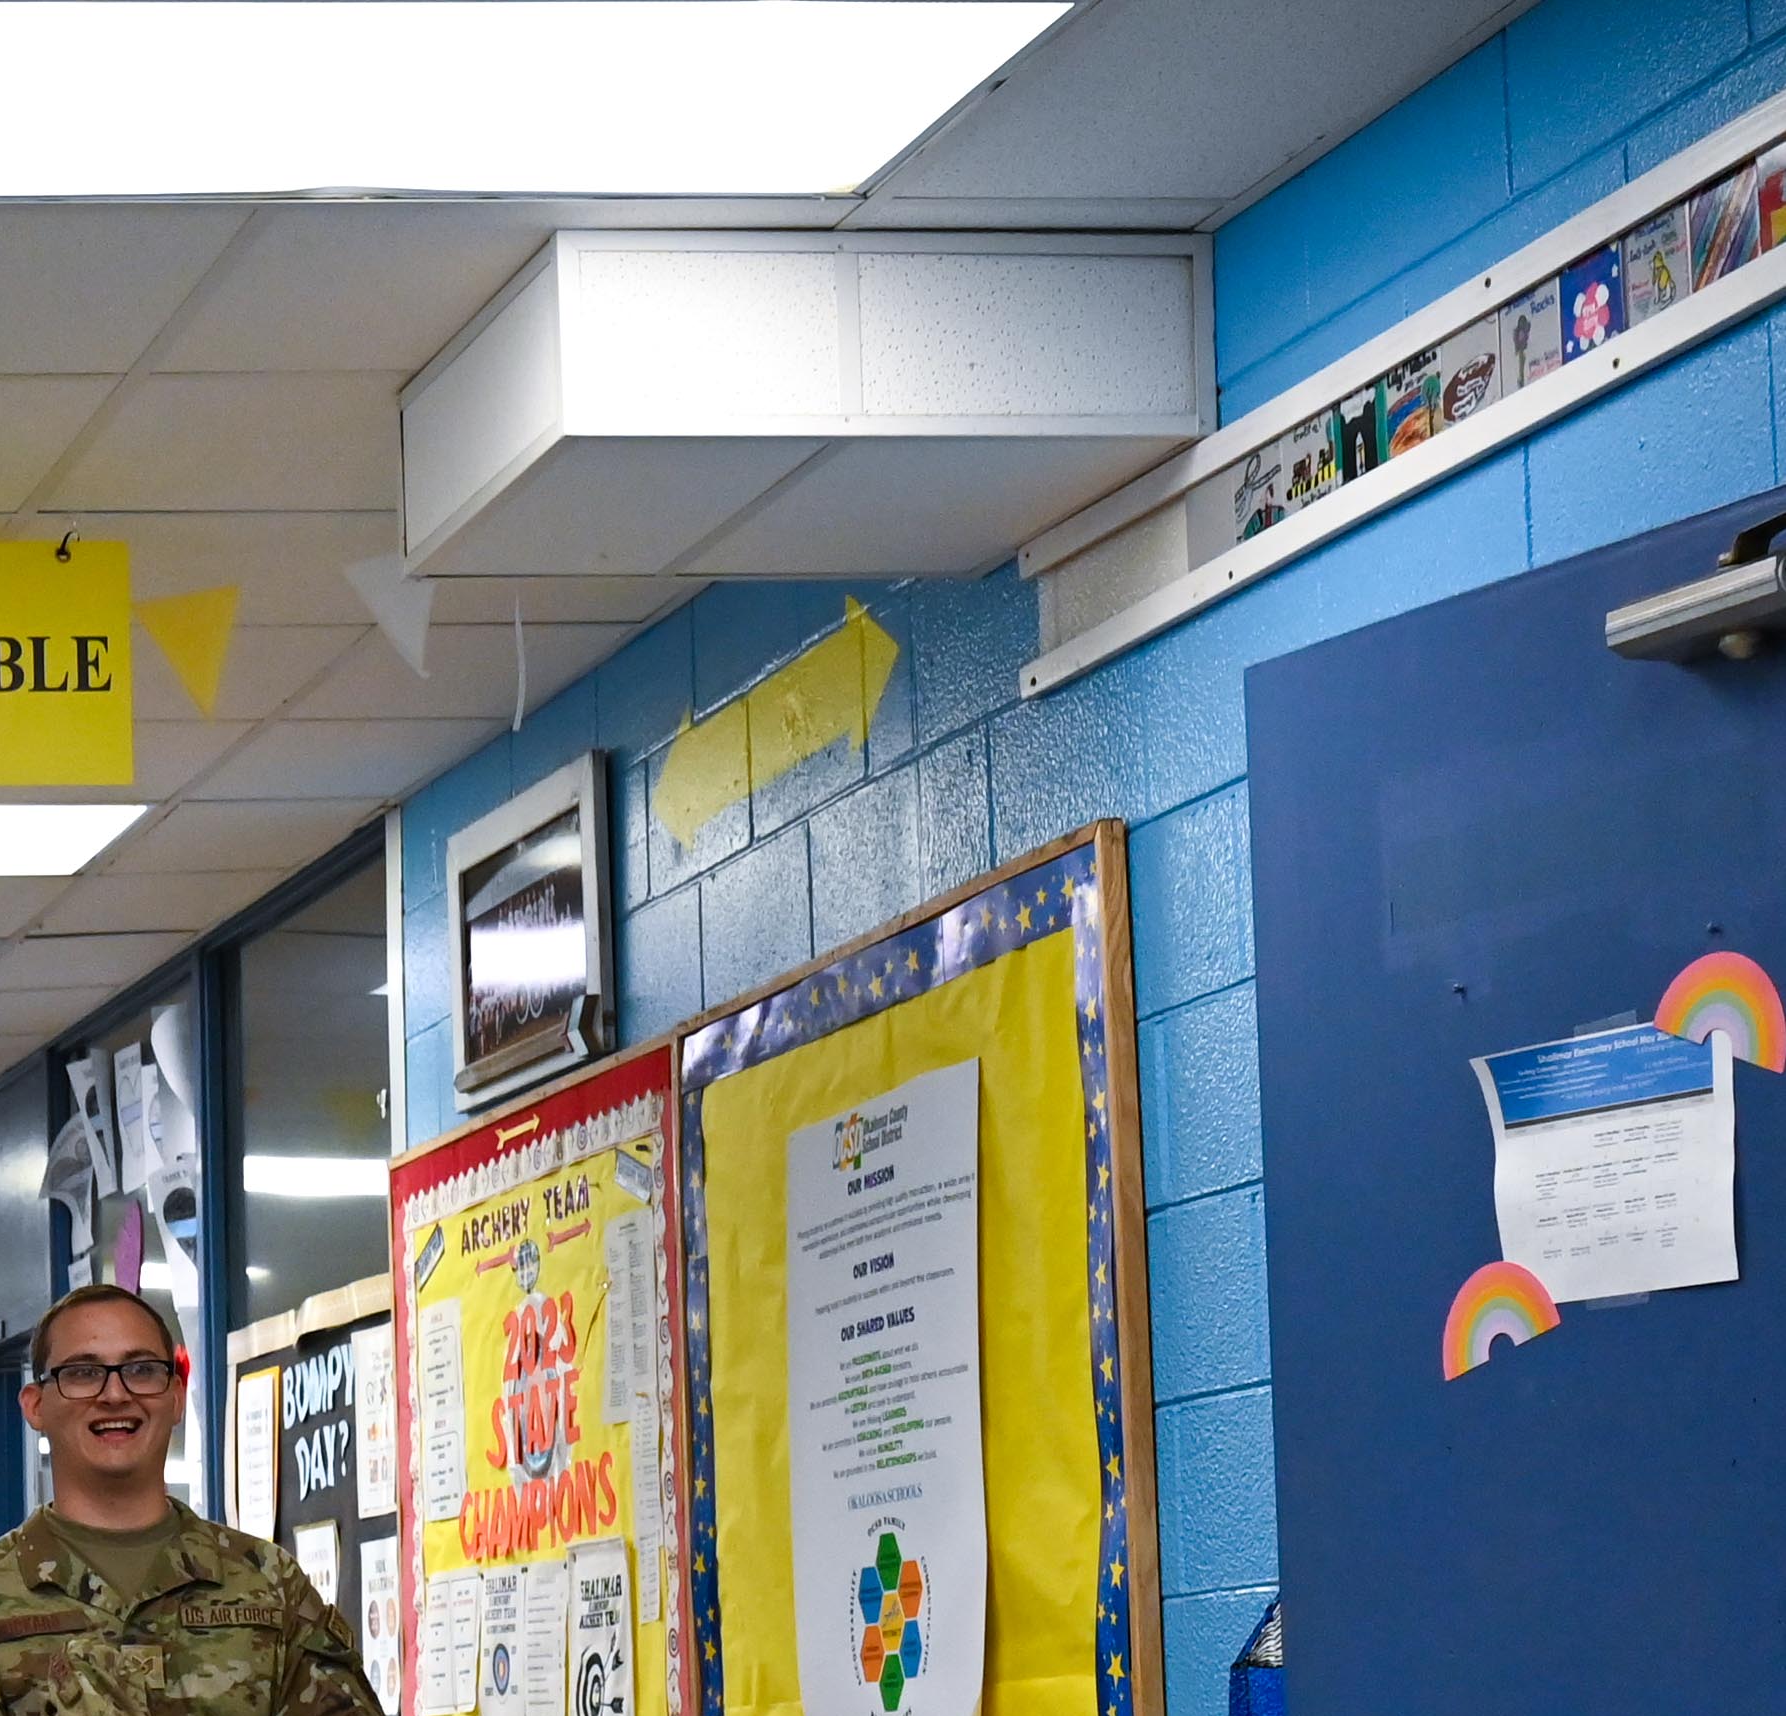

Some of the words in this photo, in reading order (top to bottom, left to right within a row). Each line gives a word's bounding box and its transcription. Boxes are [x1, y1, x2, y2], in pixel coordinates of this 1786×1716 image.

[1614, 1036, 1639, 1051] School
[847, 1178, 862, 1196] OUR
[864, 1165, 895, 1190] MISSION
[461, 1197, 530, 1257] ARCHERY
[543, 1174, 590, 1226] TEAM
[853, 1261, 868, 1280] OUR
[869, 1251, 895, 1275] VISION
[503, 1290, 577, 1384] 2023
[840, 1326, 855, 1342] OUR
[856, 1314, 885, 1338] SHARED
[887, 1306, 915, 1330] VALUES
[282, 1343, 356, 1430] BUMPY
[485, 1367, 583, 1470] STATE
[294, 1419, 349, 1502] DAY?
[459, 1451, 617, 1563] CHAMPIONS
[209, 1608, 232, 1623] AIR
[235, 1607, 277, 1624] FORCE
[580, 1574, 622, 1602] SHALIMAR
